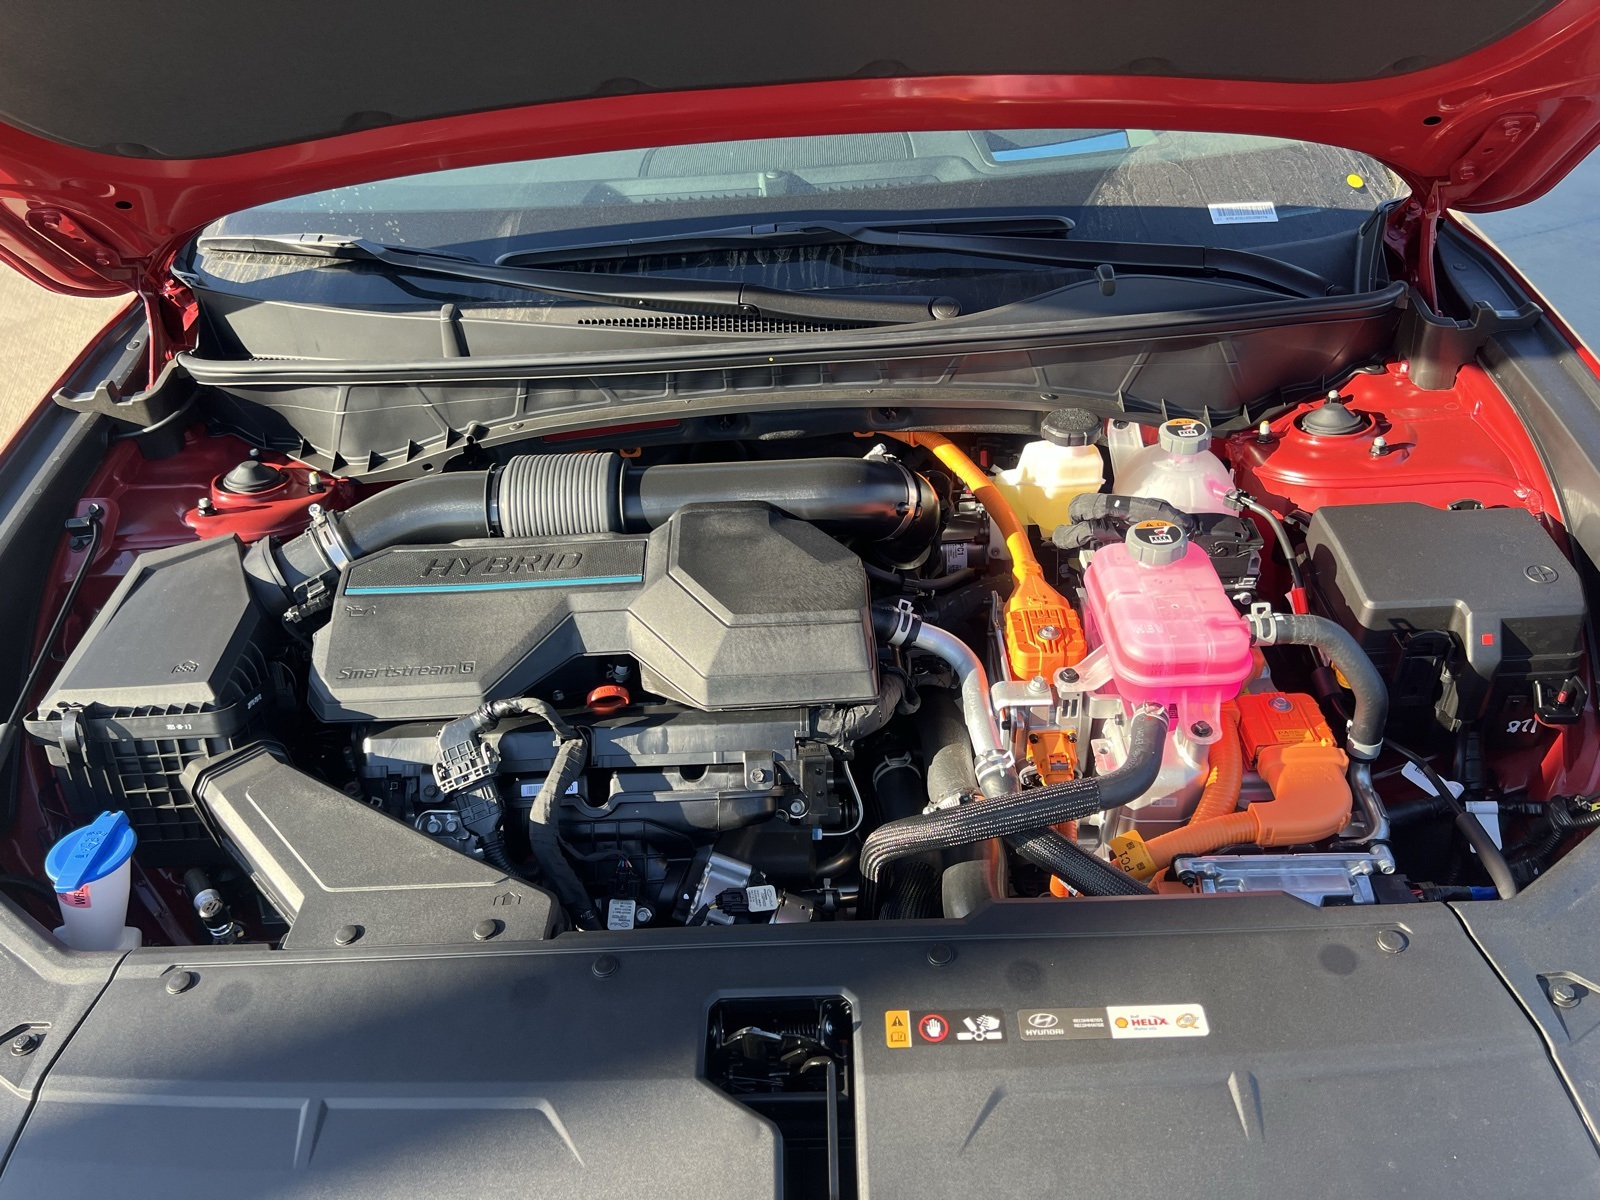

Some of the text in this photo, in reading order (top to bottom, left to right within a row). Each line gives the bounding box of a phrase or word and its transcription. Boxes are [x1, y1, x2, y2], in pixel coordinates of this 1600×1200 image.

[420, 551, 583, 578] HYBRID
[336, 660, 476, 680] Smartstream G
[1118, 850, 1135, 873] PC1
[1025, 1028, 1065, 1036] HYUNDAI
[1131, 1018, 1168, 1026] HELIX
